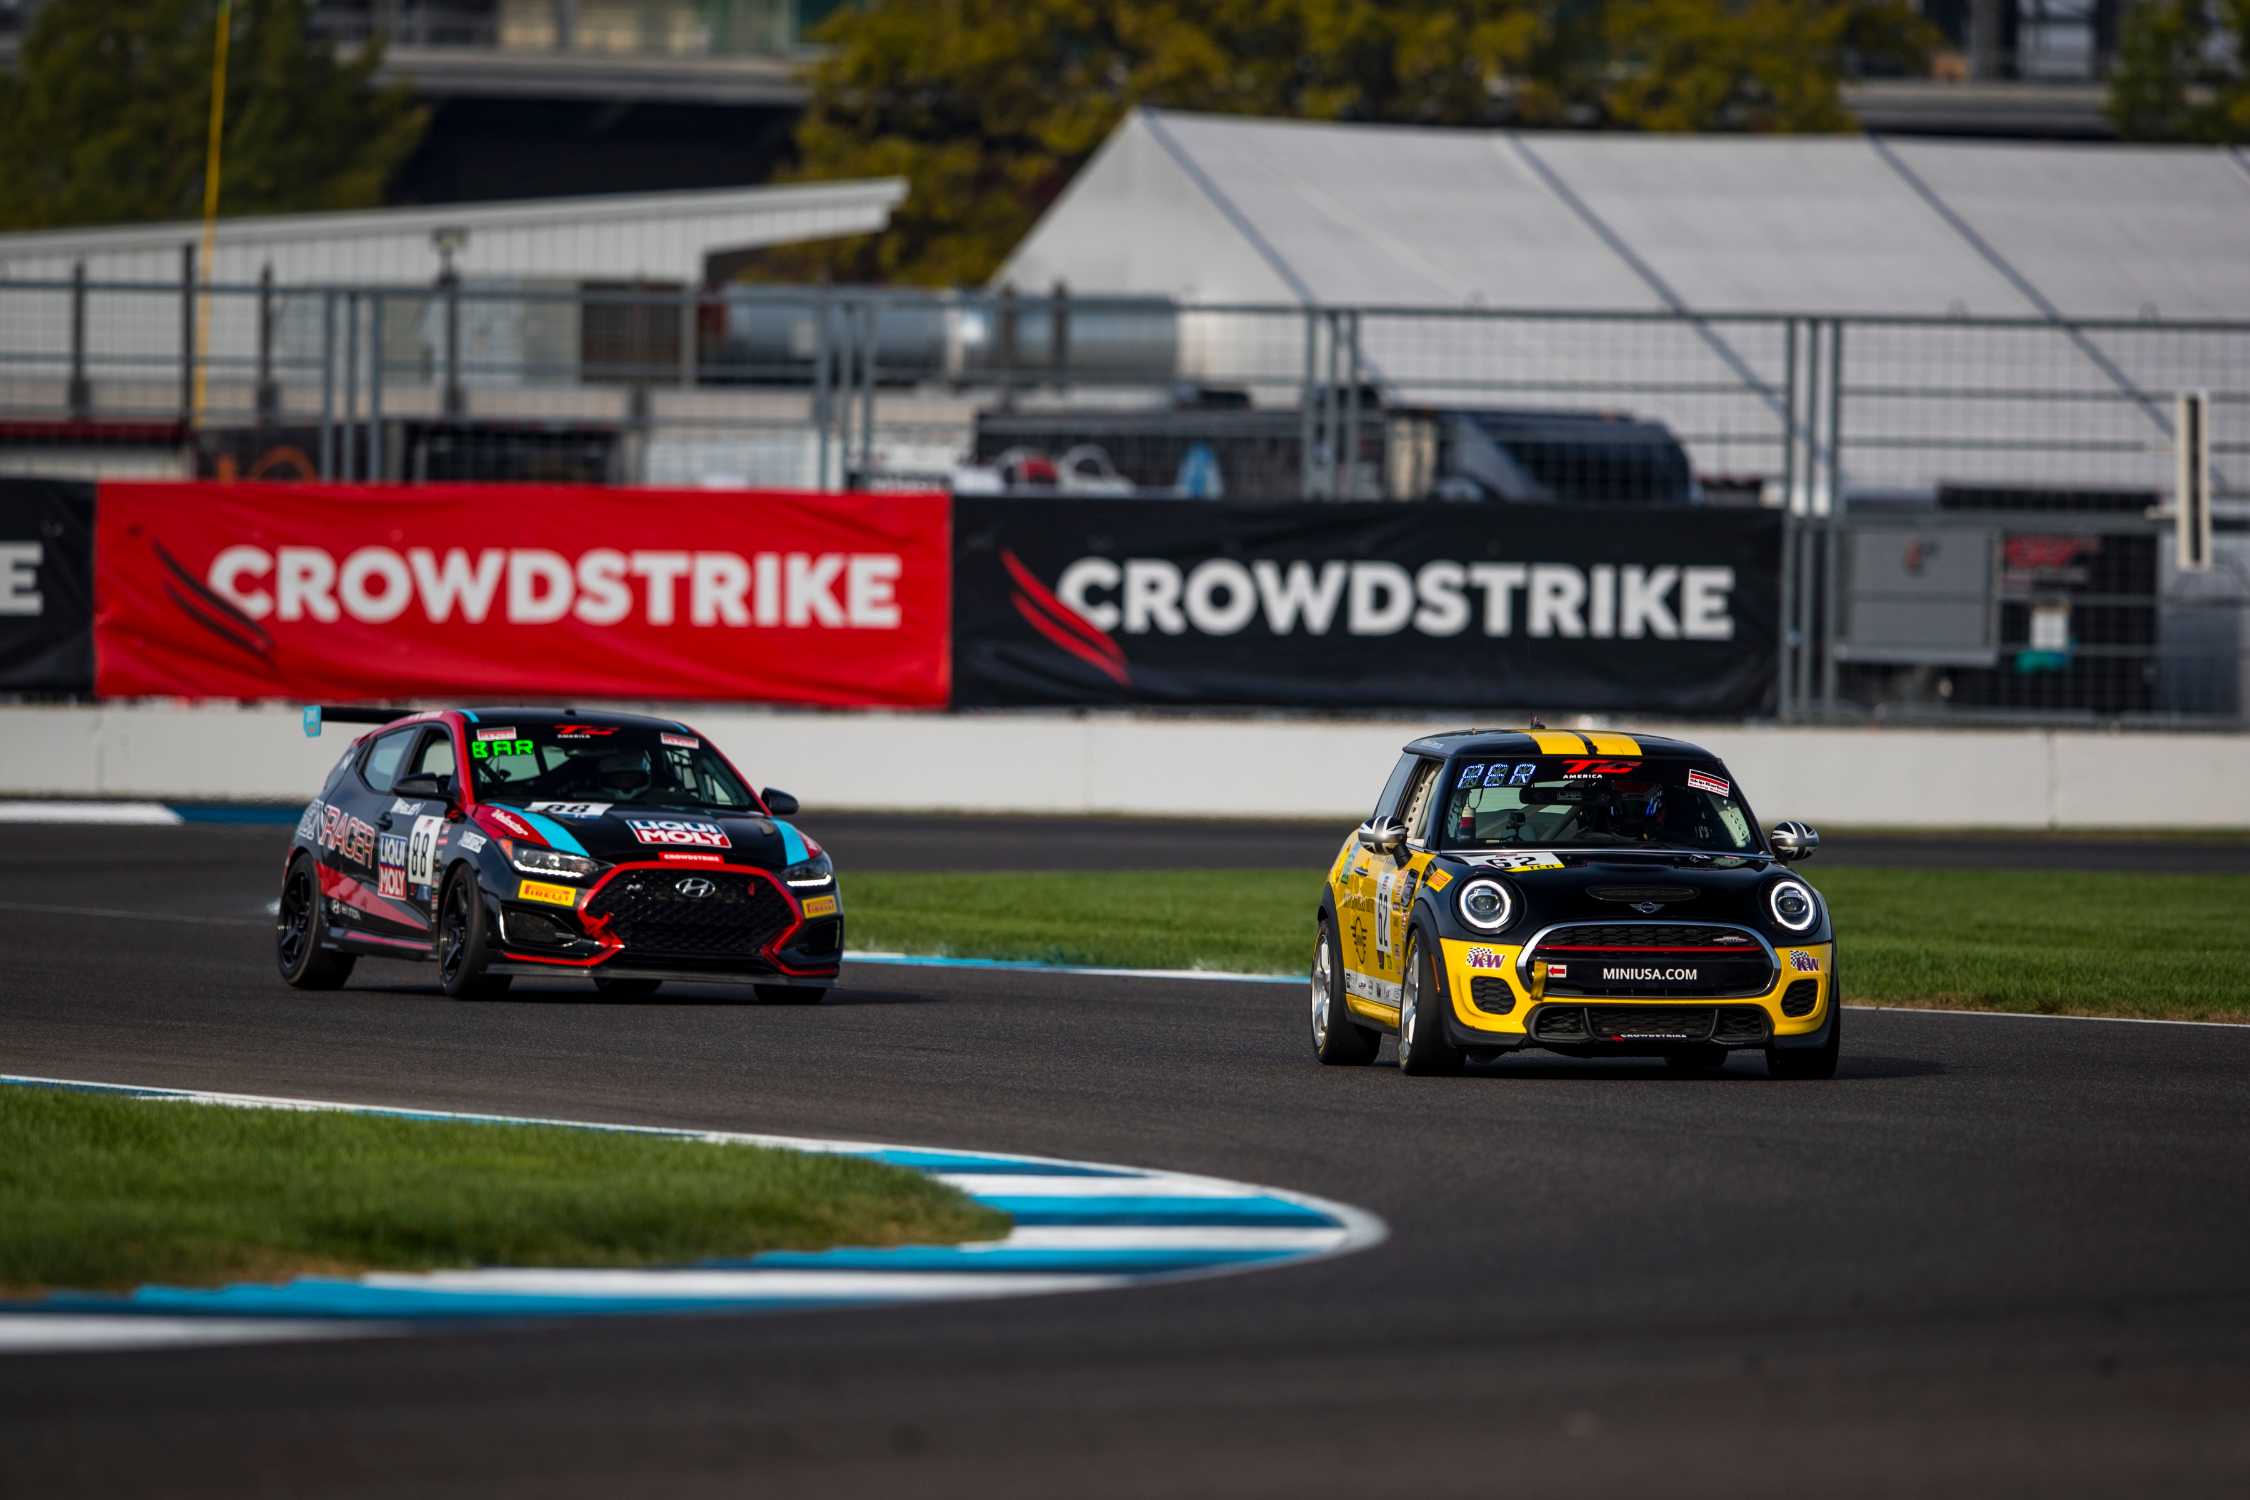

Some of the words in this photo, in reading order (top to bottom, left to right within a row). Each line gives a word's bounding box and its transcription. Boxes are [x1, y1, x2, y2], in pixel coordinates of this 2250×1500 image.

[208, 543, 902, 631] CROWDSTRIKE
[1057, 558, 1735, 642] CROWDSTRIKE
[471, 739, 534, 759] BAR
[318, 804, 376, 870] RACER
[633, 819, 718, 834] LIQUI
[642, 830, 724, 846] MOLY
[380, 836, 407, 867] LIQUI
[411, 831, 431, 878] 88
[664, 853, 720, 862] CROWDSTRIKE
[1485, 856, 1540, 869] 62
[379, 866, 407, 897] MOLY
[523, 884, 571, 904] PIRELLI
[1377, 893, 1388, 947] 62
[1602, 967, 1698, 981] MINIUSA.COM
